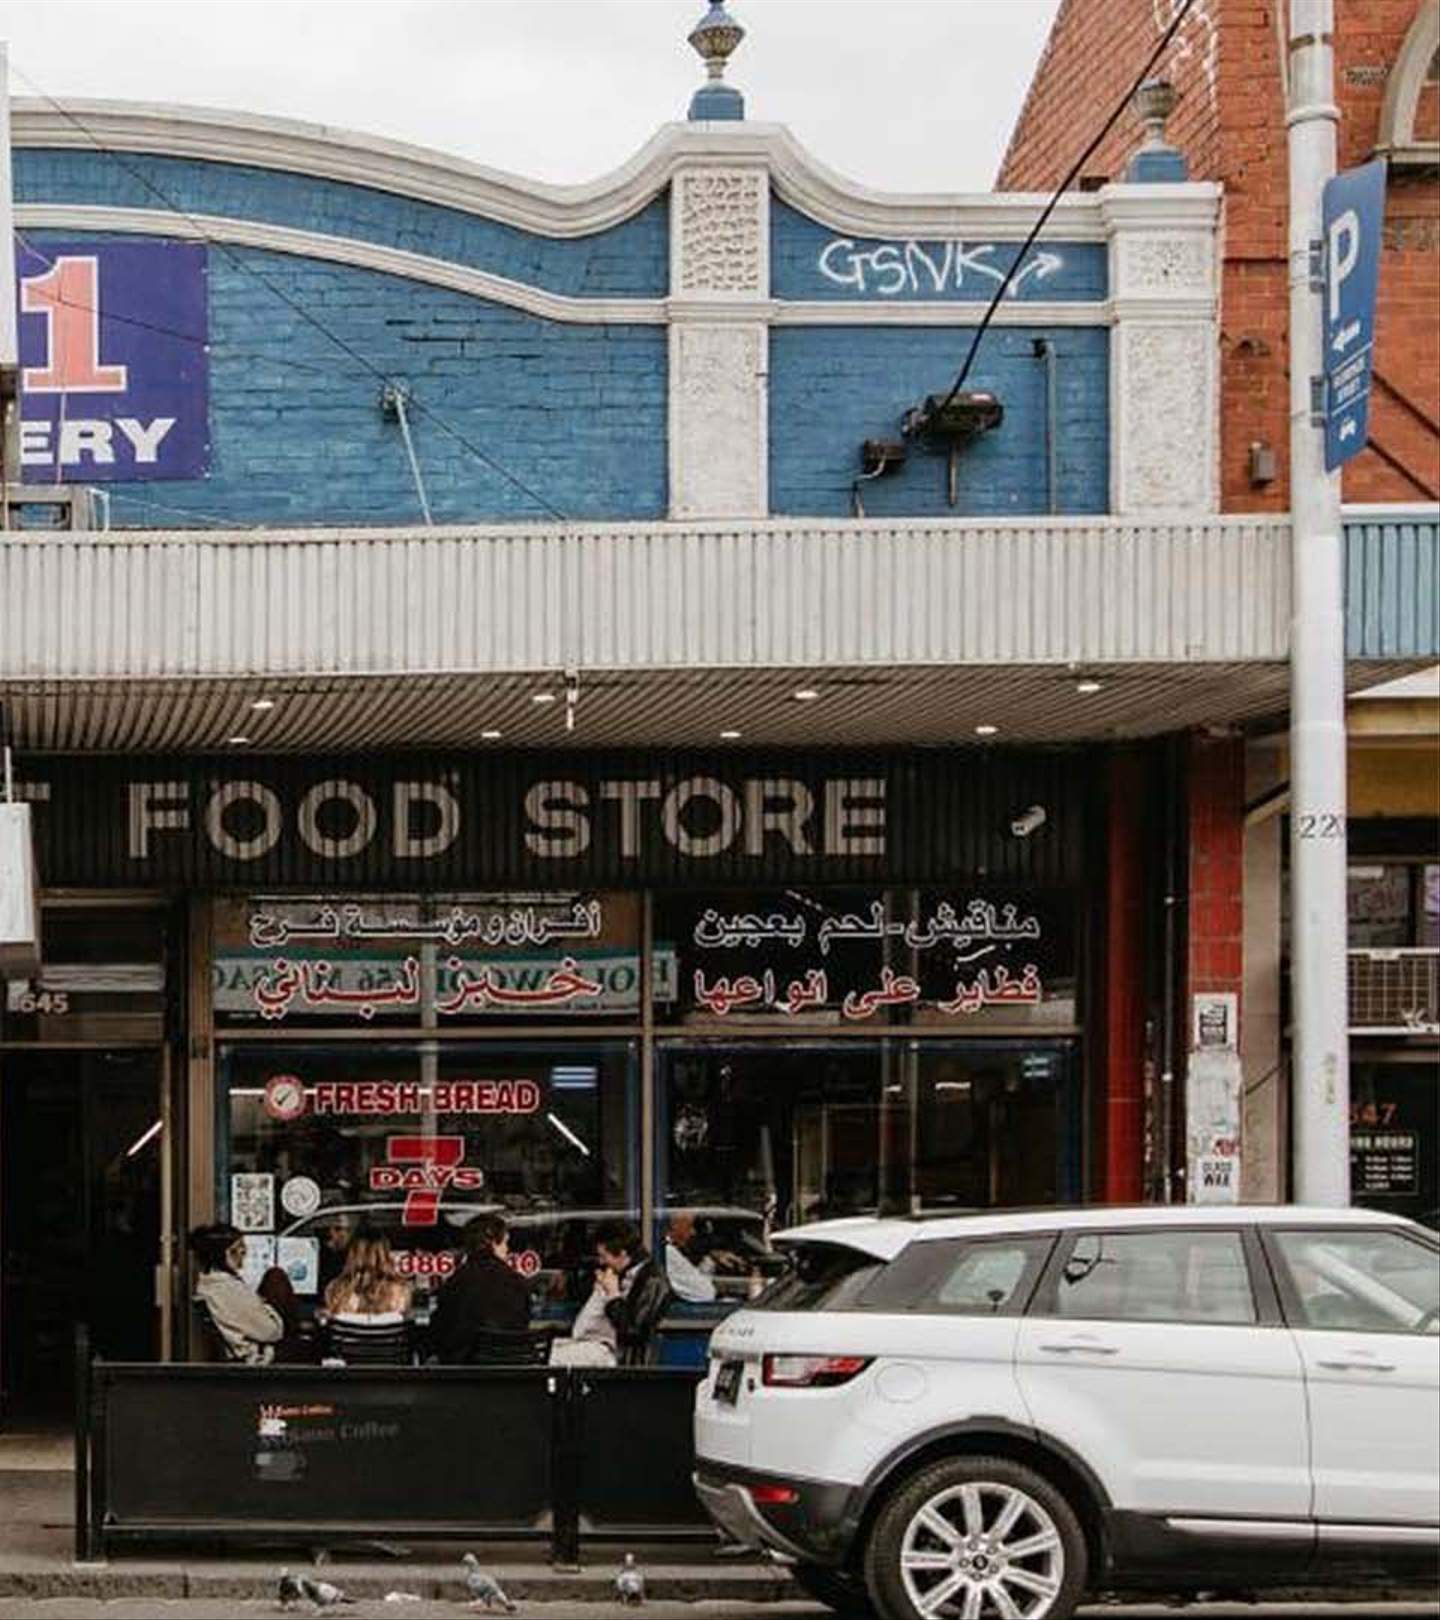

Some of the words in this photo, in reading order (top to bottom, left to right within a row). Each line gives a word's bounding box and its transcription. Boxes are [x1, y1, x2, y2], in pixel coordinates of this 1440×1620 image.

[818, 239, 1006, 295] GSNK
[1329, 209, 1359, 320] P
[128, 780, 460, 861] FOOD
[524, 776, 886, 859] STORE
[19, 992, 70, 1014] 645
[436, 949, 603, 1014] خبز
[314, 1081, 423, 1114] FRESH
[431, 1080, 541, 1113] BREAD
[367, 1167, 484, 1189] DAYS
[385, 1135, 465, 1226] 7
